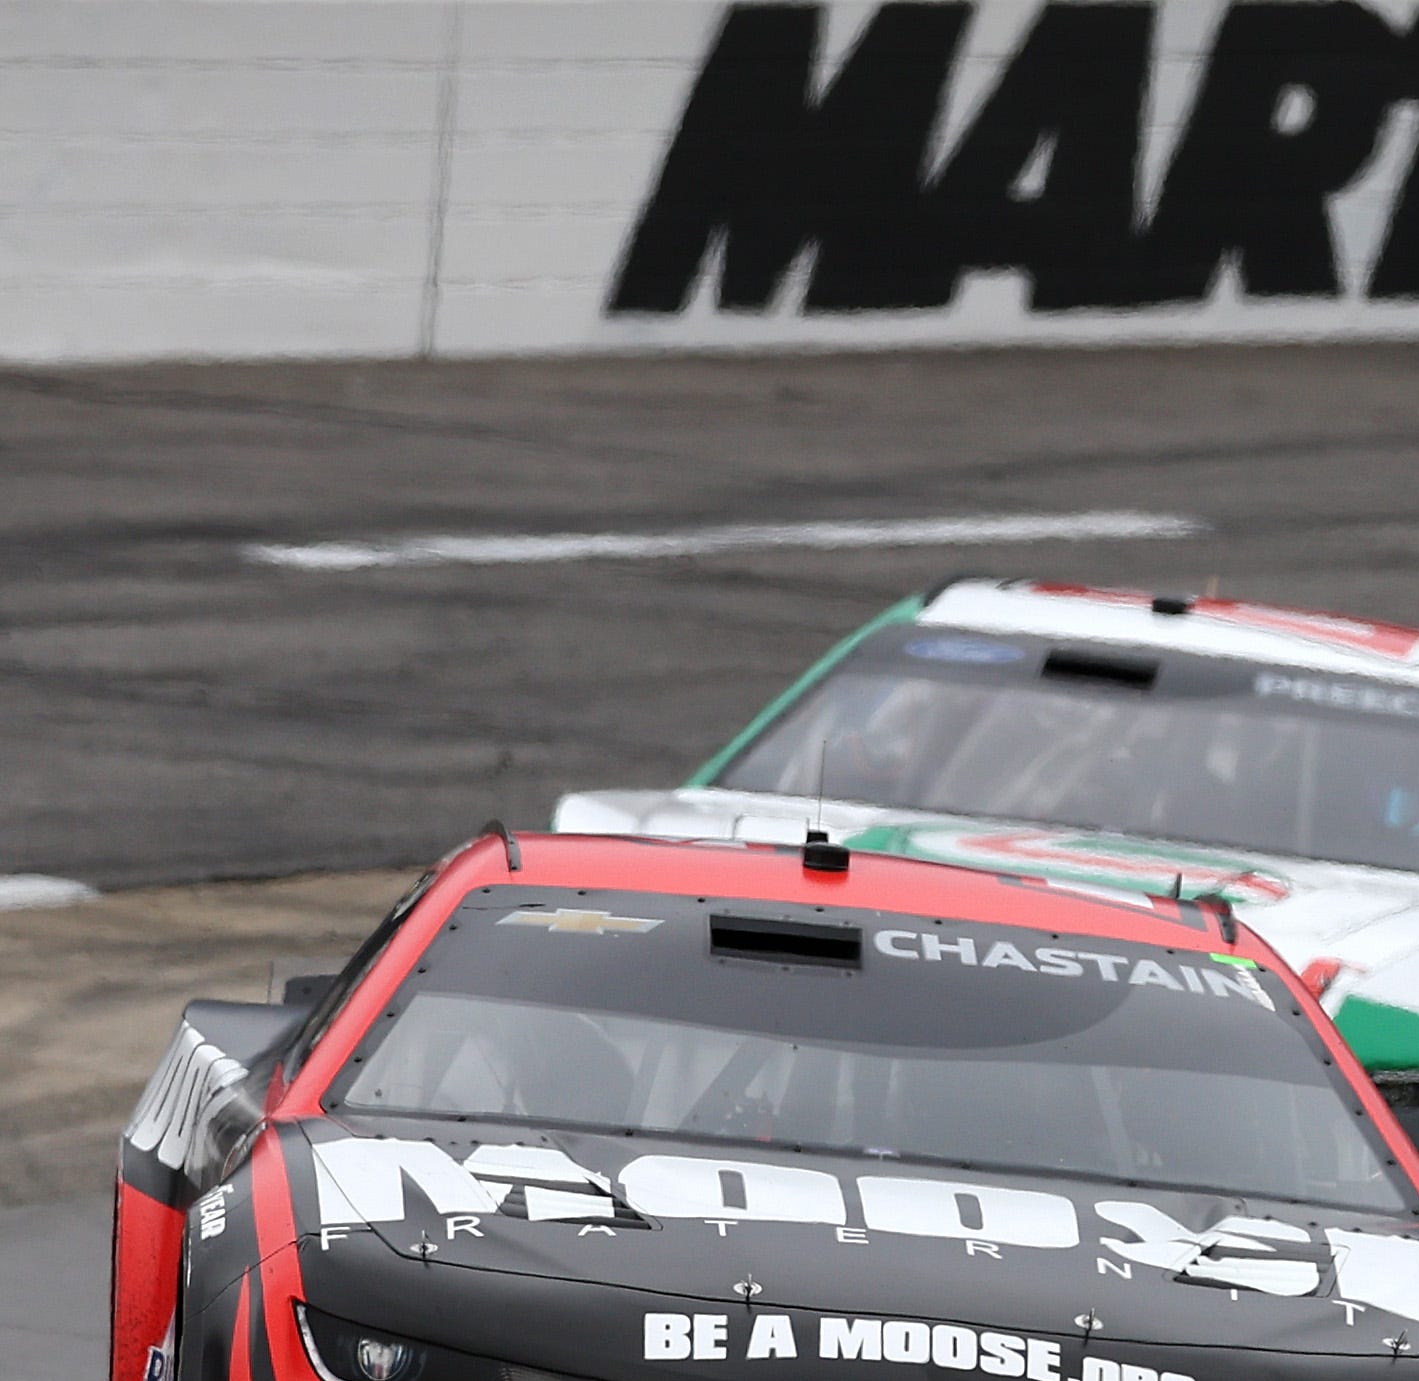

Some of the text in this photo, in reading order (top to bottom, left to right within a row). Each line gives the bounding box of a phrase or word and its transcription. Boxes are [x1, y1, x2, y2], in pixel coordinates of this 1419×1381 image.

[873, 929, 1258, 1001] CHASTAIN
[644, 1312, 728, 1361] BE
[746, 1314, 798, 1360] A
